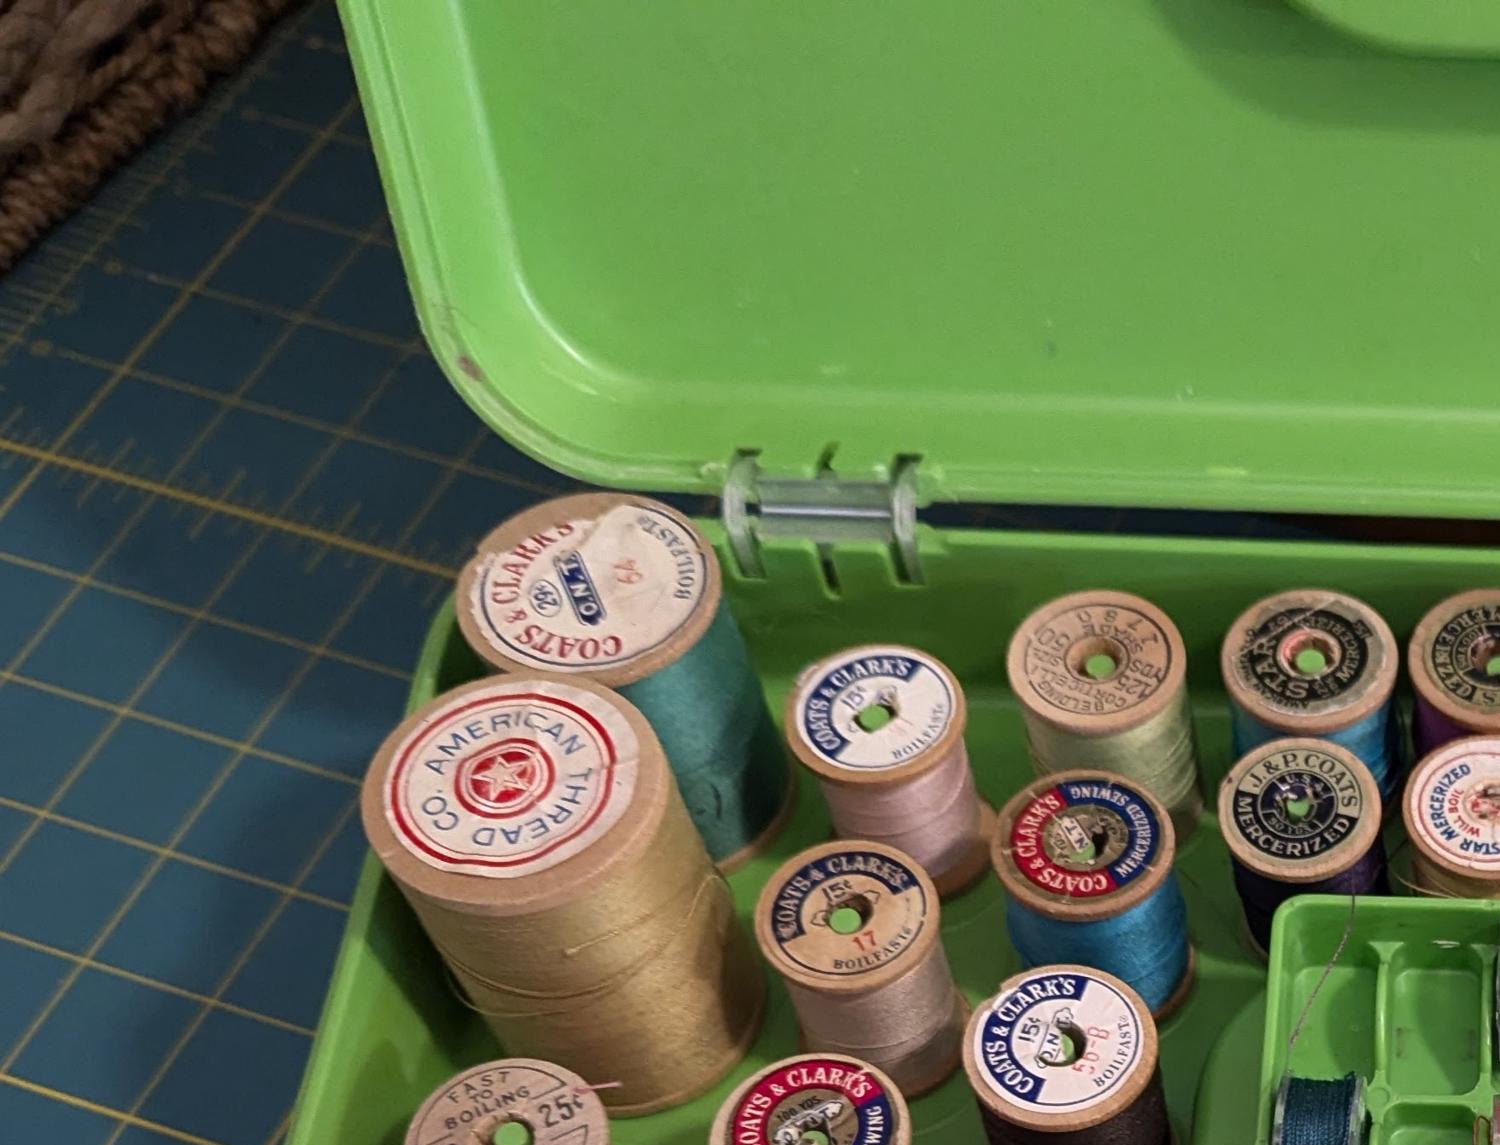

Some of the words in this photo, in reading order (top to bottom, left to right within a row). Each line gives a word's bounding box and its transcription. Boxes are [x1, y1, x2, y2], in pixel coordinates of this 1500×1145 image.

[515, 624, 623, 659] COATS
[808, 699, 841, 750] COATS
[832, 657, 912, 686] CLARK'S
[1031, 665, 1127, 708] CORTICELLI
[1038, 681, 1105, 712] BELDING
[423, 711, 586, 776] AMERICAN
[1070, 786, 1131, 807] SEWING
[1304, 753, 1359, 808] COATS
[1448, 789, 1464, 813] BOIL
[422, 789, 460, 832] CO.
[472, 767, 593, 846] THREAD
[1430, 763, 1471, 842] MERCERIZED
[1017, 795, 1061, 858] CLARK'S
[1115, 803, 1152, 877] MERCERIZED
[1237, 796, 1350, 857] MERCERIZED
[1452, 816, 1480, 838] WILL
[1459, 838, 1500, 855] STAR
[822, 879, 853, 902] 15¢
[1037, 867, 1108, 892] COATS
[853, 930, 878, 951] 17
[999, 977, 1076, 1022] CLARK'S
[1018, 1017, 1042, 1043] 15¢
[447, 1071, 510, 1104] FAST
[786, 1066, 873, 1098] CLARK'S
[986, 1041, 1034, 1093] COATS
[444, 1086, 531, 1130] BOILING
